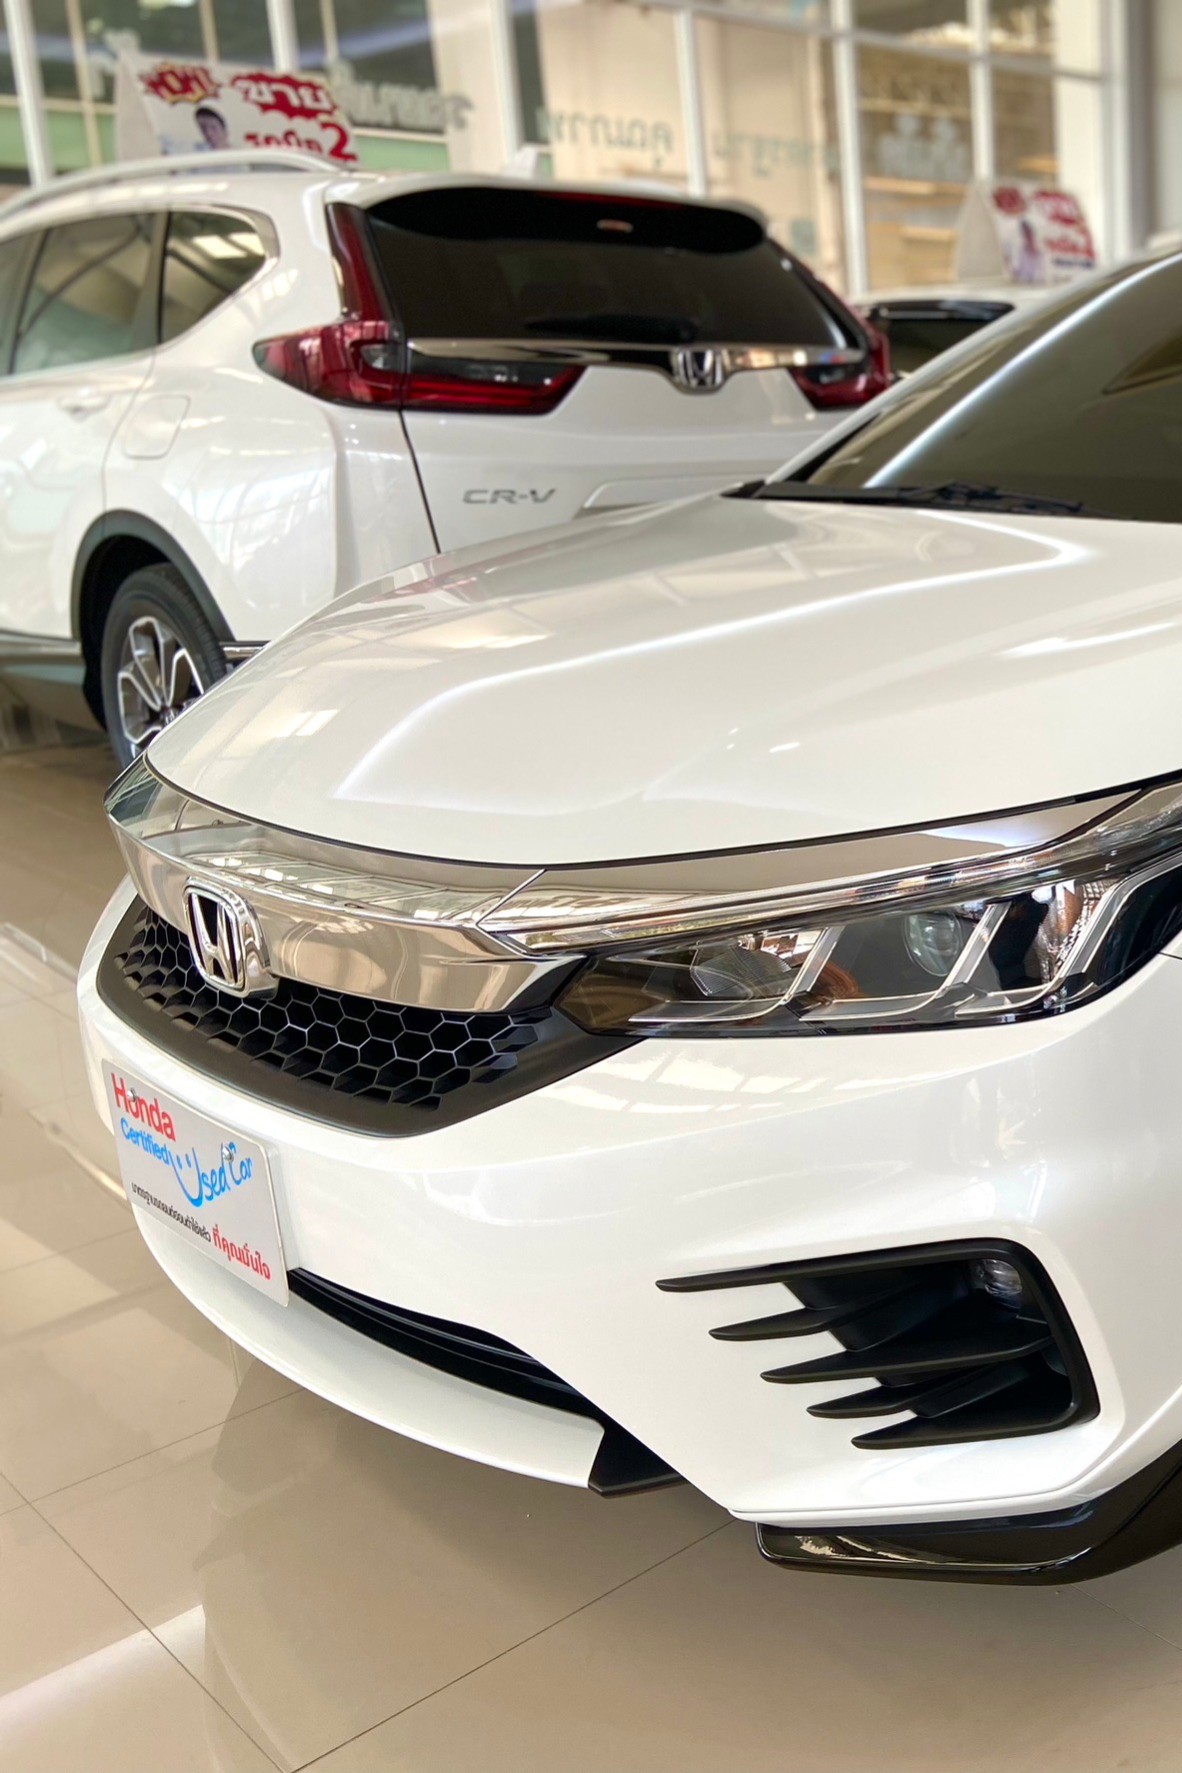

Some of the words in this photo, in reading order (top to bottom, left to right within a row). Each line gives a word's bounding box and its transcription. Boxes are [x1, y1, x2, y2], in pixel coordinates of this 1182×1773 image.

[463, 488, 556, 504] CR-V
[111, 1072, 177, 1142] Honda
[120, 1117, 171, 1167] Certified
[212, 1224, 271, 1281] ที่คุณมั่นใจ
